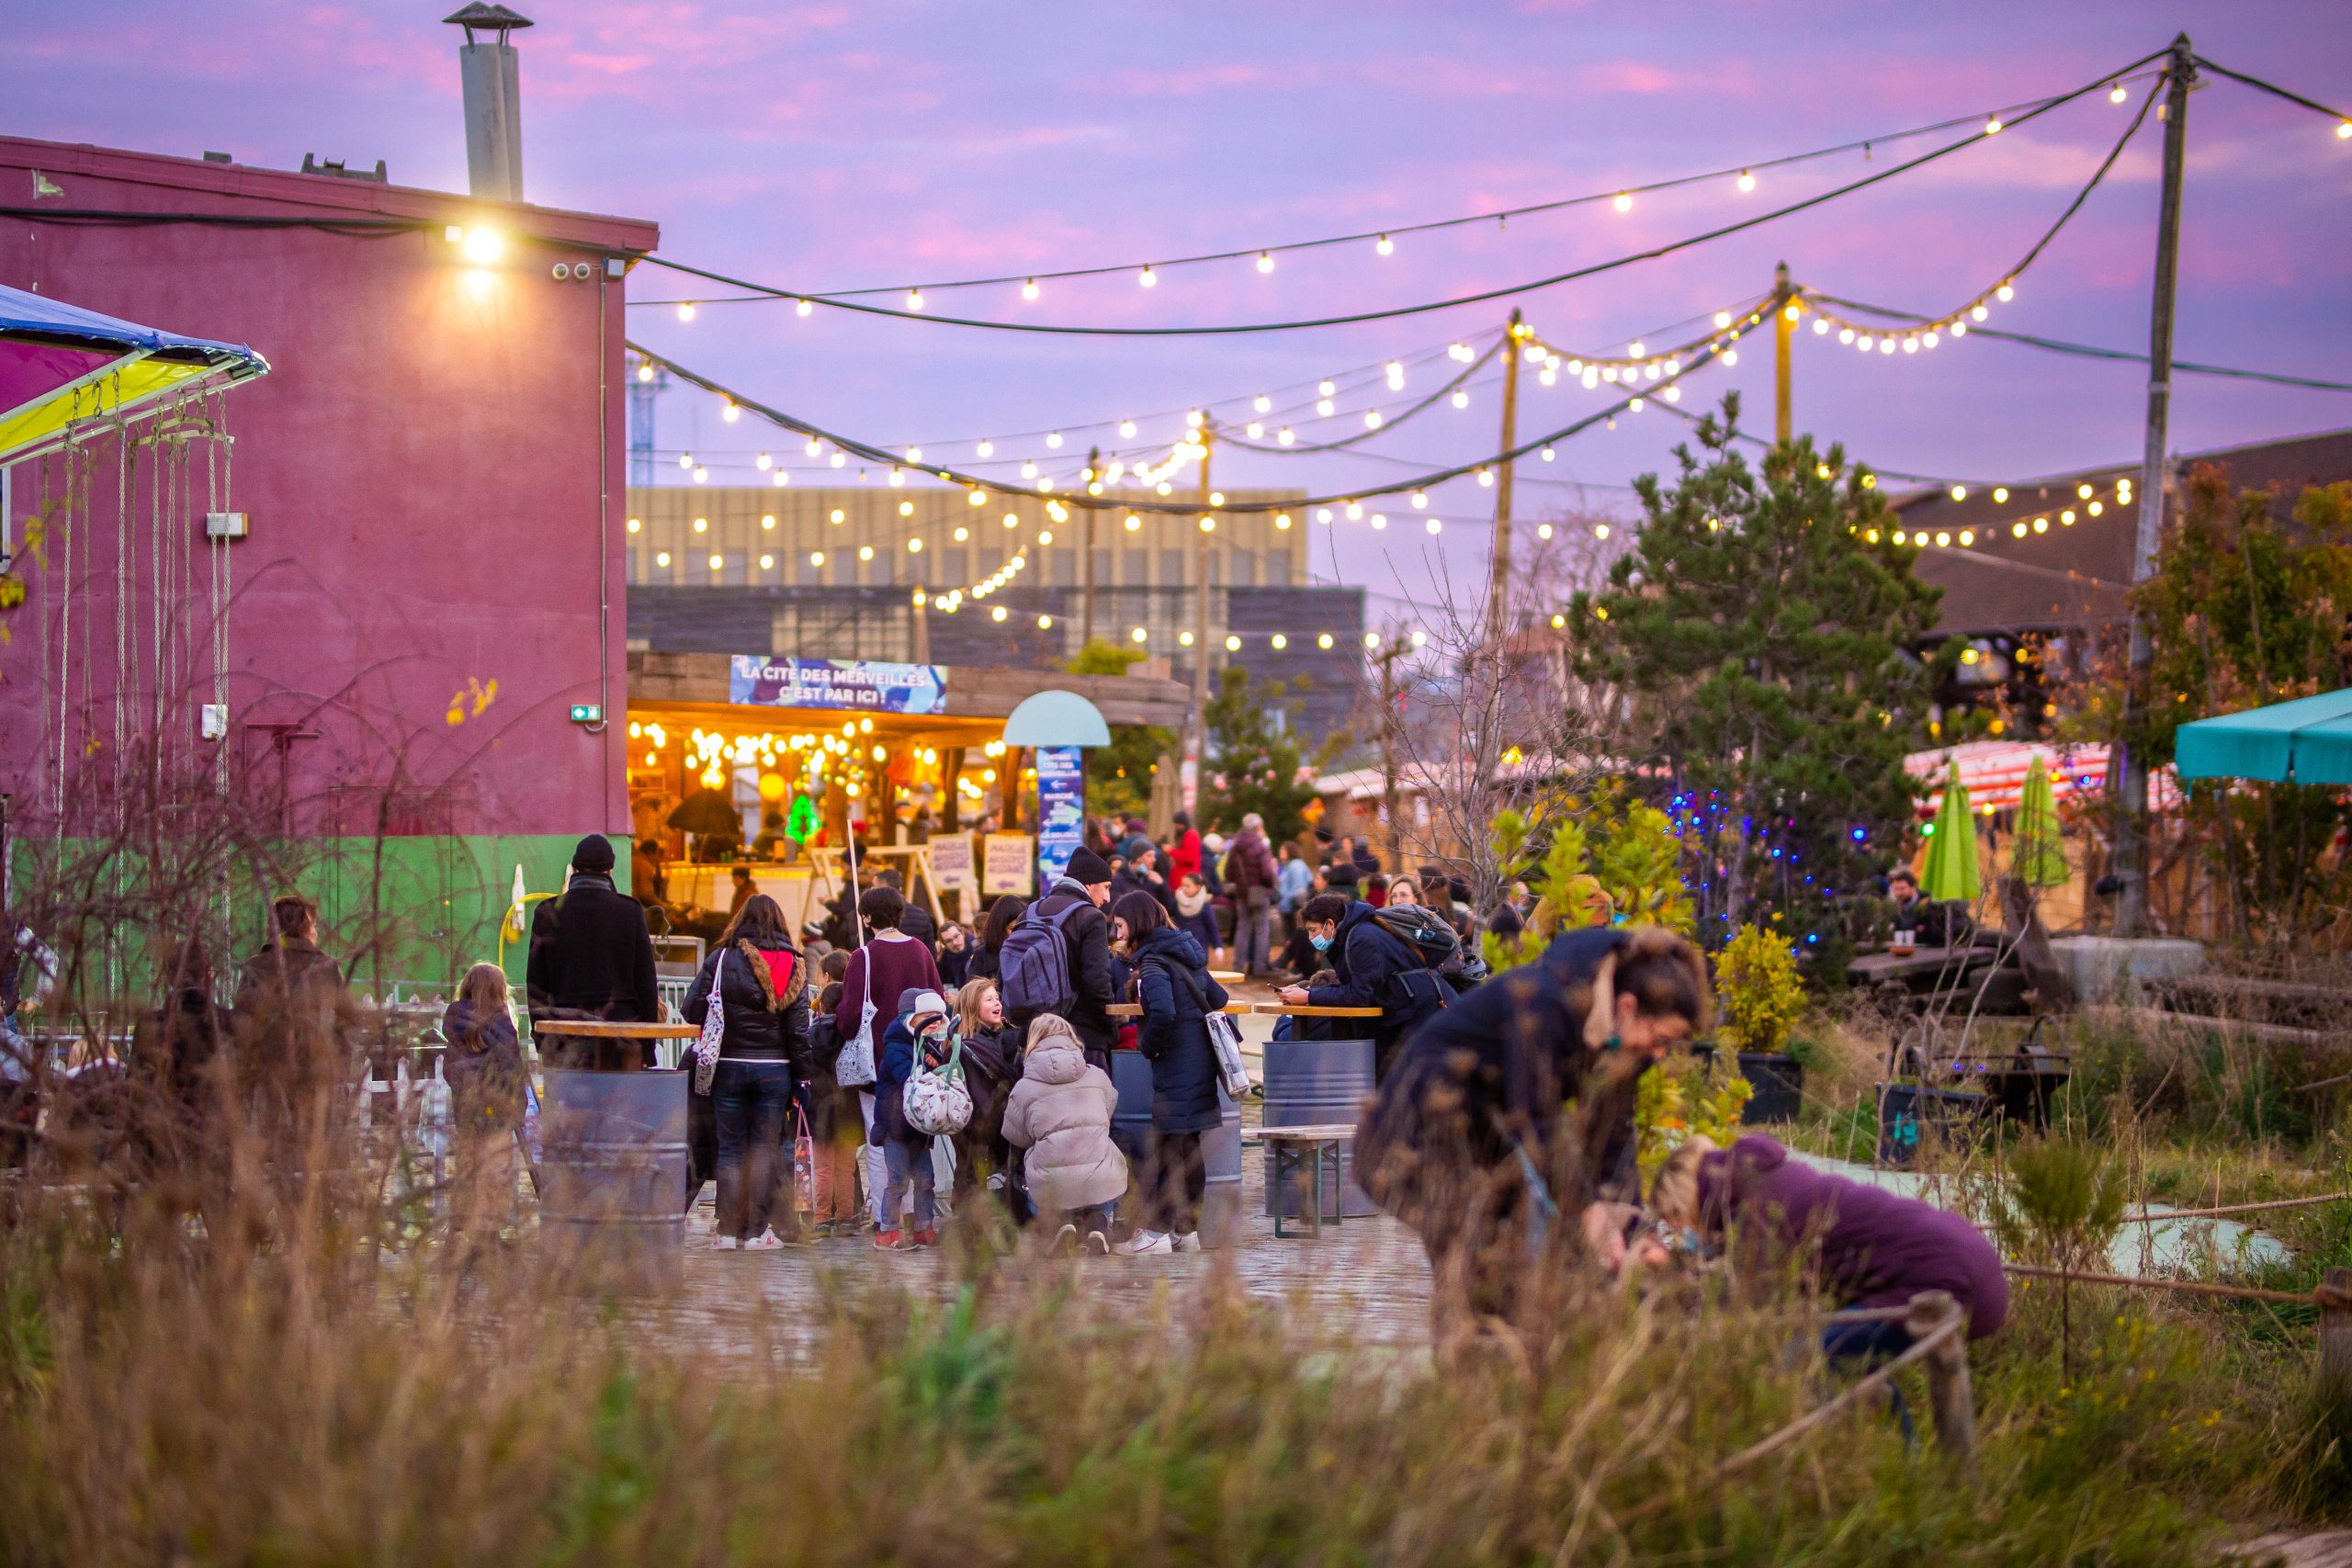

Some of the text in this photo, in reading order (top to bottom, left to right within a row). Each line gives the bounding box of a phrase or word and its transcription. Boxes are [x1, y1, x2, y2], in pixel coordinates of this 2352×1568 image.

[741, 665, 761, 680] LA
[800, 668, 831, 682] DES
[832, 670, 926, 687] MERVEILLES
[778, 685, 822, 701] C'EST
[824, 688, 854, 703] PAR
[855, 689, 877, 705] ICI
